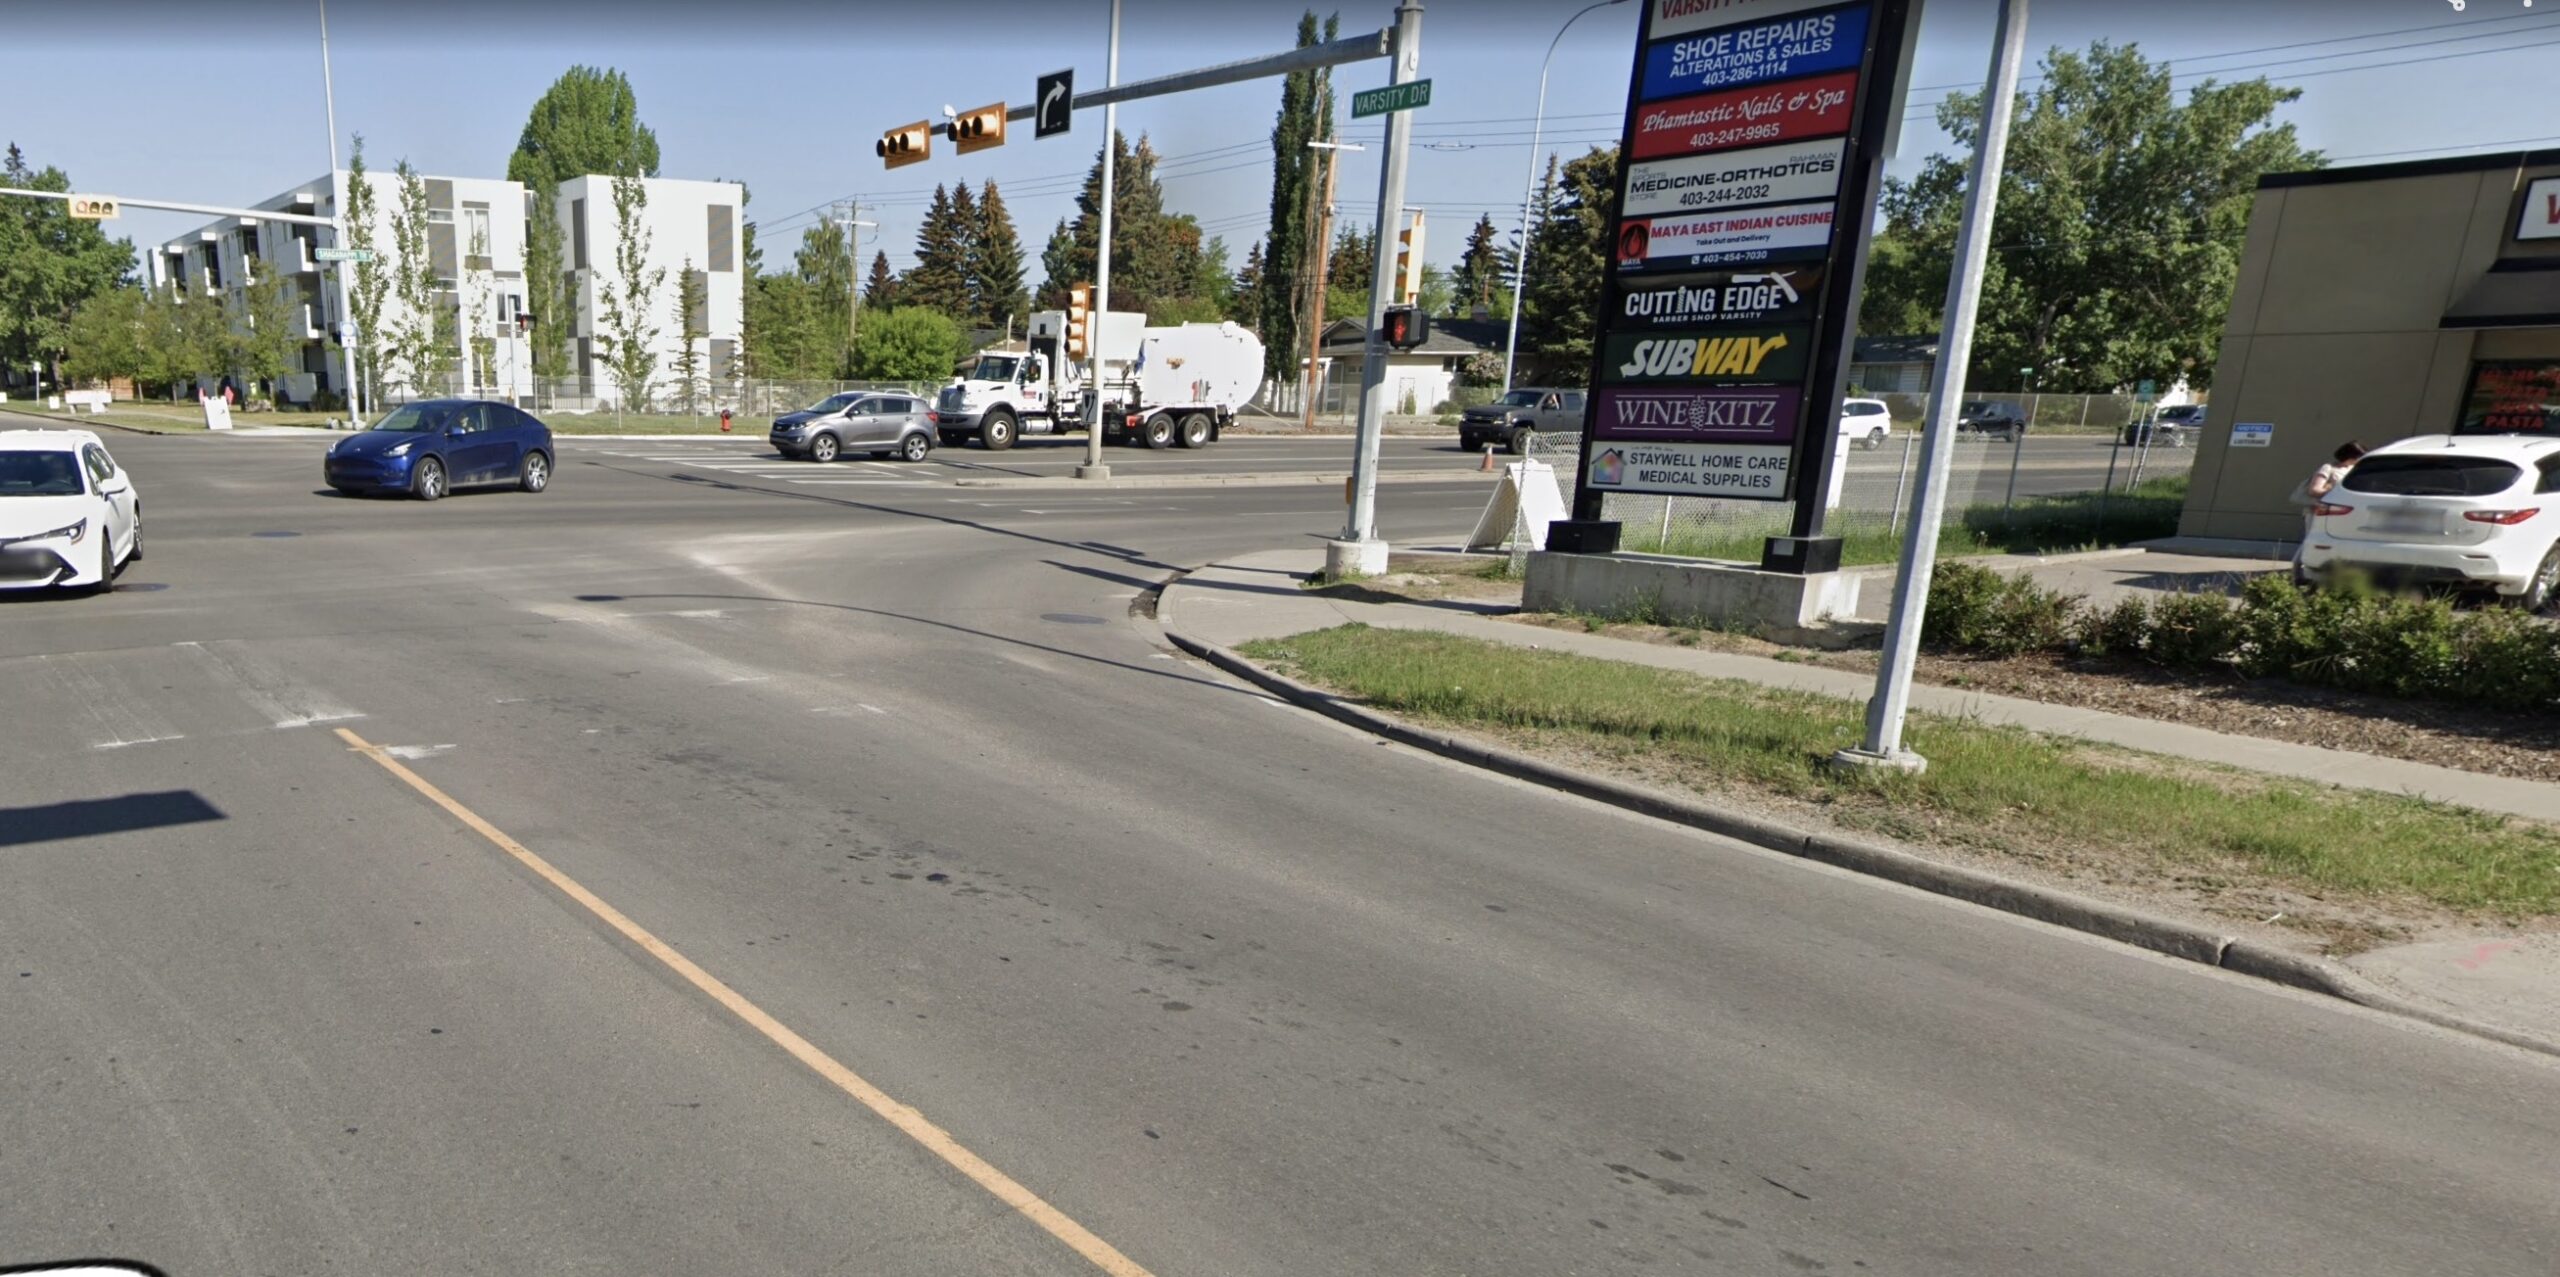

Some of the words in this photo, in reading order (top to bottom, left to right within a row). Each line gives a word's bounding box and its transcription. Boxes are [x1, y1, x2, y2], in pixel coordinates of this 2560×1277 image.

[1672, 34, 1732, 63] SHOE
[1737, 15, 1836, 51] REPAIRS
[1670, 49, 1763, 78] ALTERATIONS
[1767, 47, 1777, 61] &
[1781, 37, 1832, 58] SALES
[1702, 61, 1788, 86] 403-286-1114
[1355, 88, 1405, 113] VARSITY
[1410, 84, 1428, 104] DR
[1642, 104, 1734, 133] Phamtastic
[1737, 93, 1784, 121] Nails
[1788, 93, 1810, 111] &
[1809, 88, 1846, 115] Spa
[1690, 122, 1780, 147] 403-247-9965
[1679, 184, 1770, 206] 403-244-2032
[1651, 223, 1689, 239] MAYA
[1692, 220, 1723, 235] EAST
[1725, 216, 1773, 232] INDIAN
[1776, 211, 1833, 227] CUISINE
[1696, 238, 1712, 246] Take
[1713, 237, 1726, 245] Out
[1726, 236, 1740, 244] and
[1740, 234, 1771, 243] Delivery
[1702, 250, 1768, 264] 403-454-7030
[1625, 285, 1716, 317] CUTTING
[1722, 284, 1783, 311] EDGE
[1653, 314, 1689, 323] BARBER
[1691, 313, 1717, 321] SHOP
[1720, 311, 1762, 320] VARSITY
[1619, 332, 1788, 378] SUBWAY
[1615, 400, 1689, 426] WINE
[1705, 400, 1776, 426] KITZ
[1630, 452, 1697, 468] STAYWELL
[1702, 454, 1743, 469] HOME
[1747, 455, 1788, 470] CARE
[1639, 469, 1698, 485] MEDICAL
[1703, 472, 1772, 488] SUPPLIES
